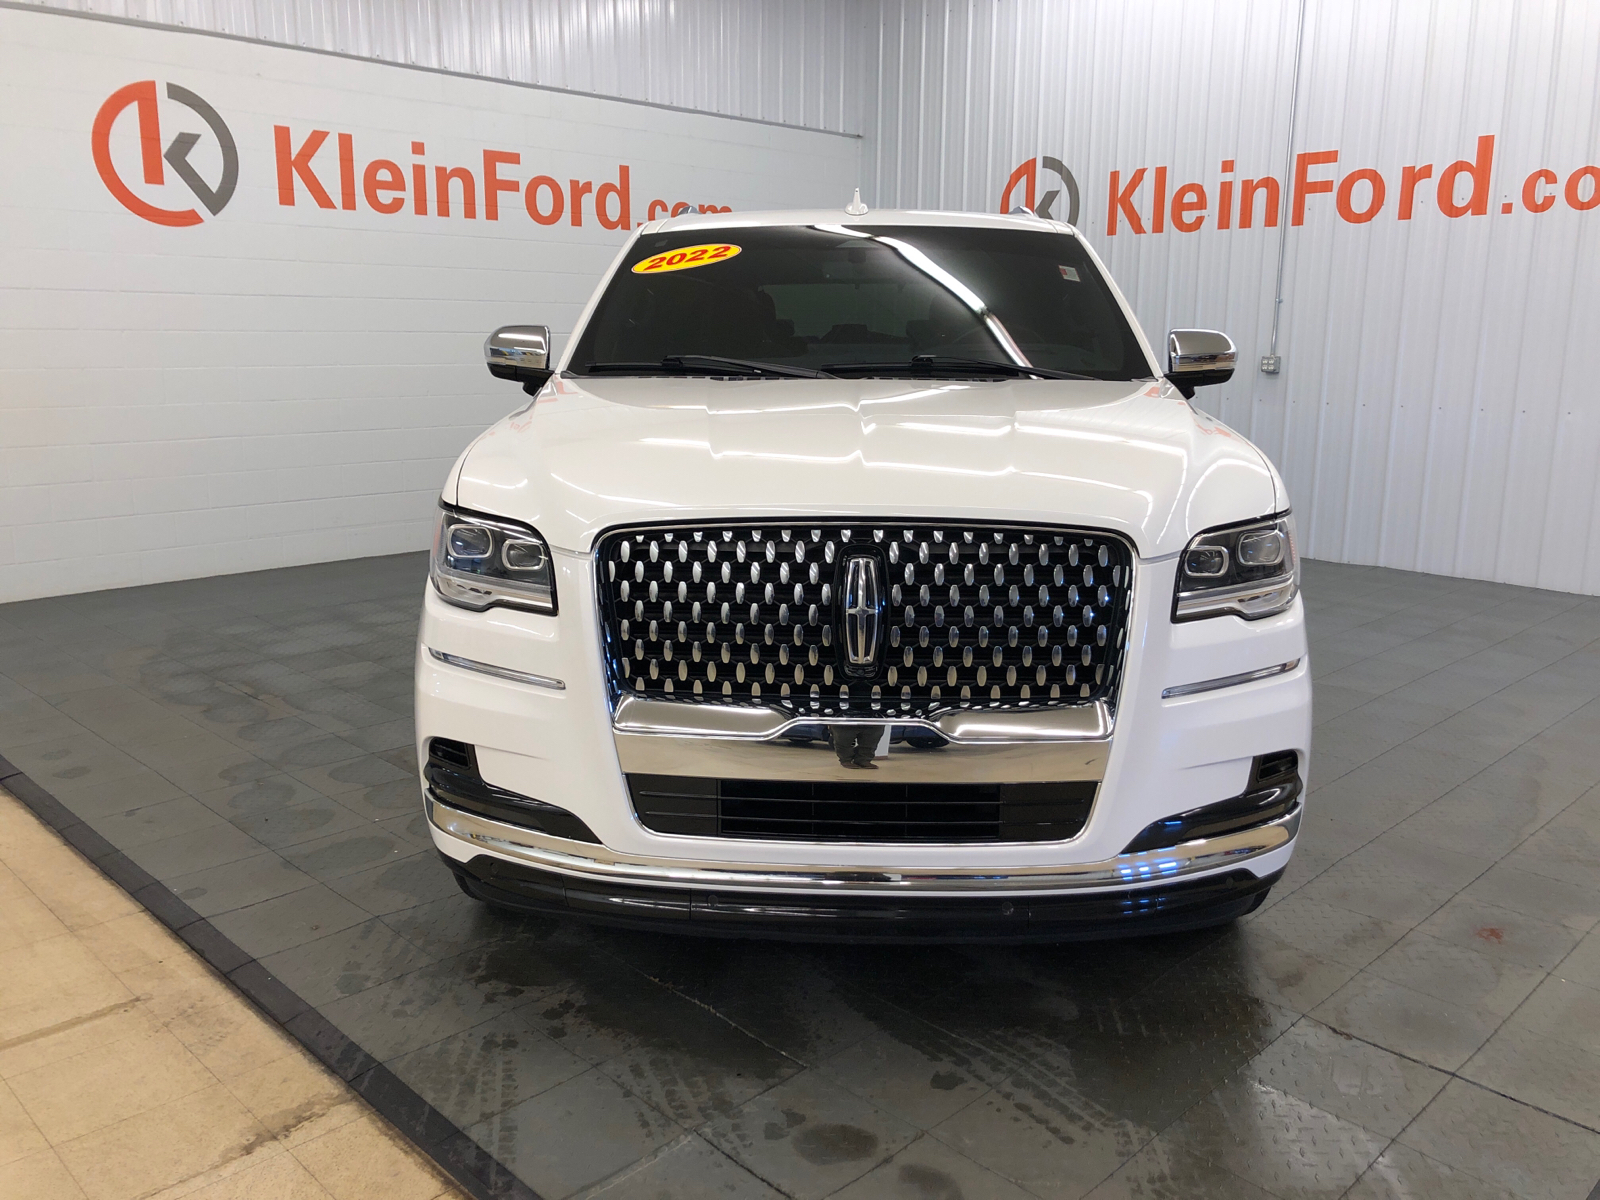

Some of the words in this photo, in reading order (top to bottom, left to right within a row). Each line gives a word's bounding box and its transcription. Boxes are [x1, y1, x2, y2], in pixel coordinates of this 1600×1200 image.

[273, 125, 733, 231] KleinFord.c
[1107, 134, 1600, 236] KleinFord.co
[643, 245, 731, 271] 2022
